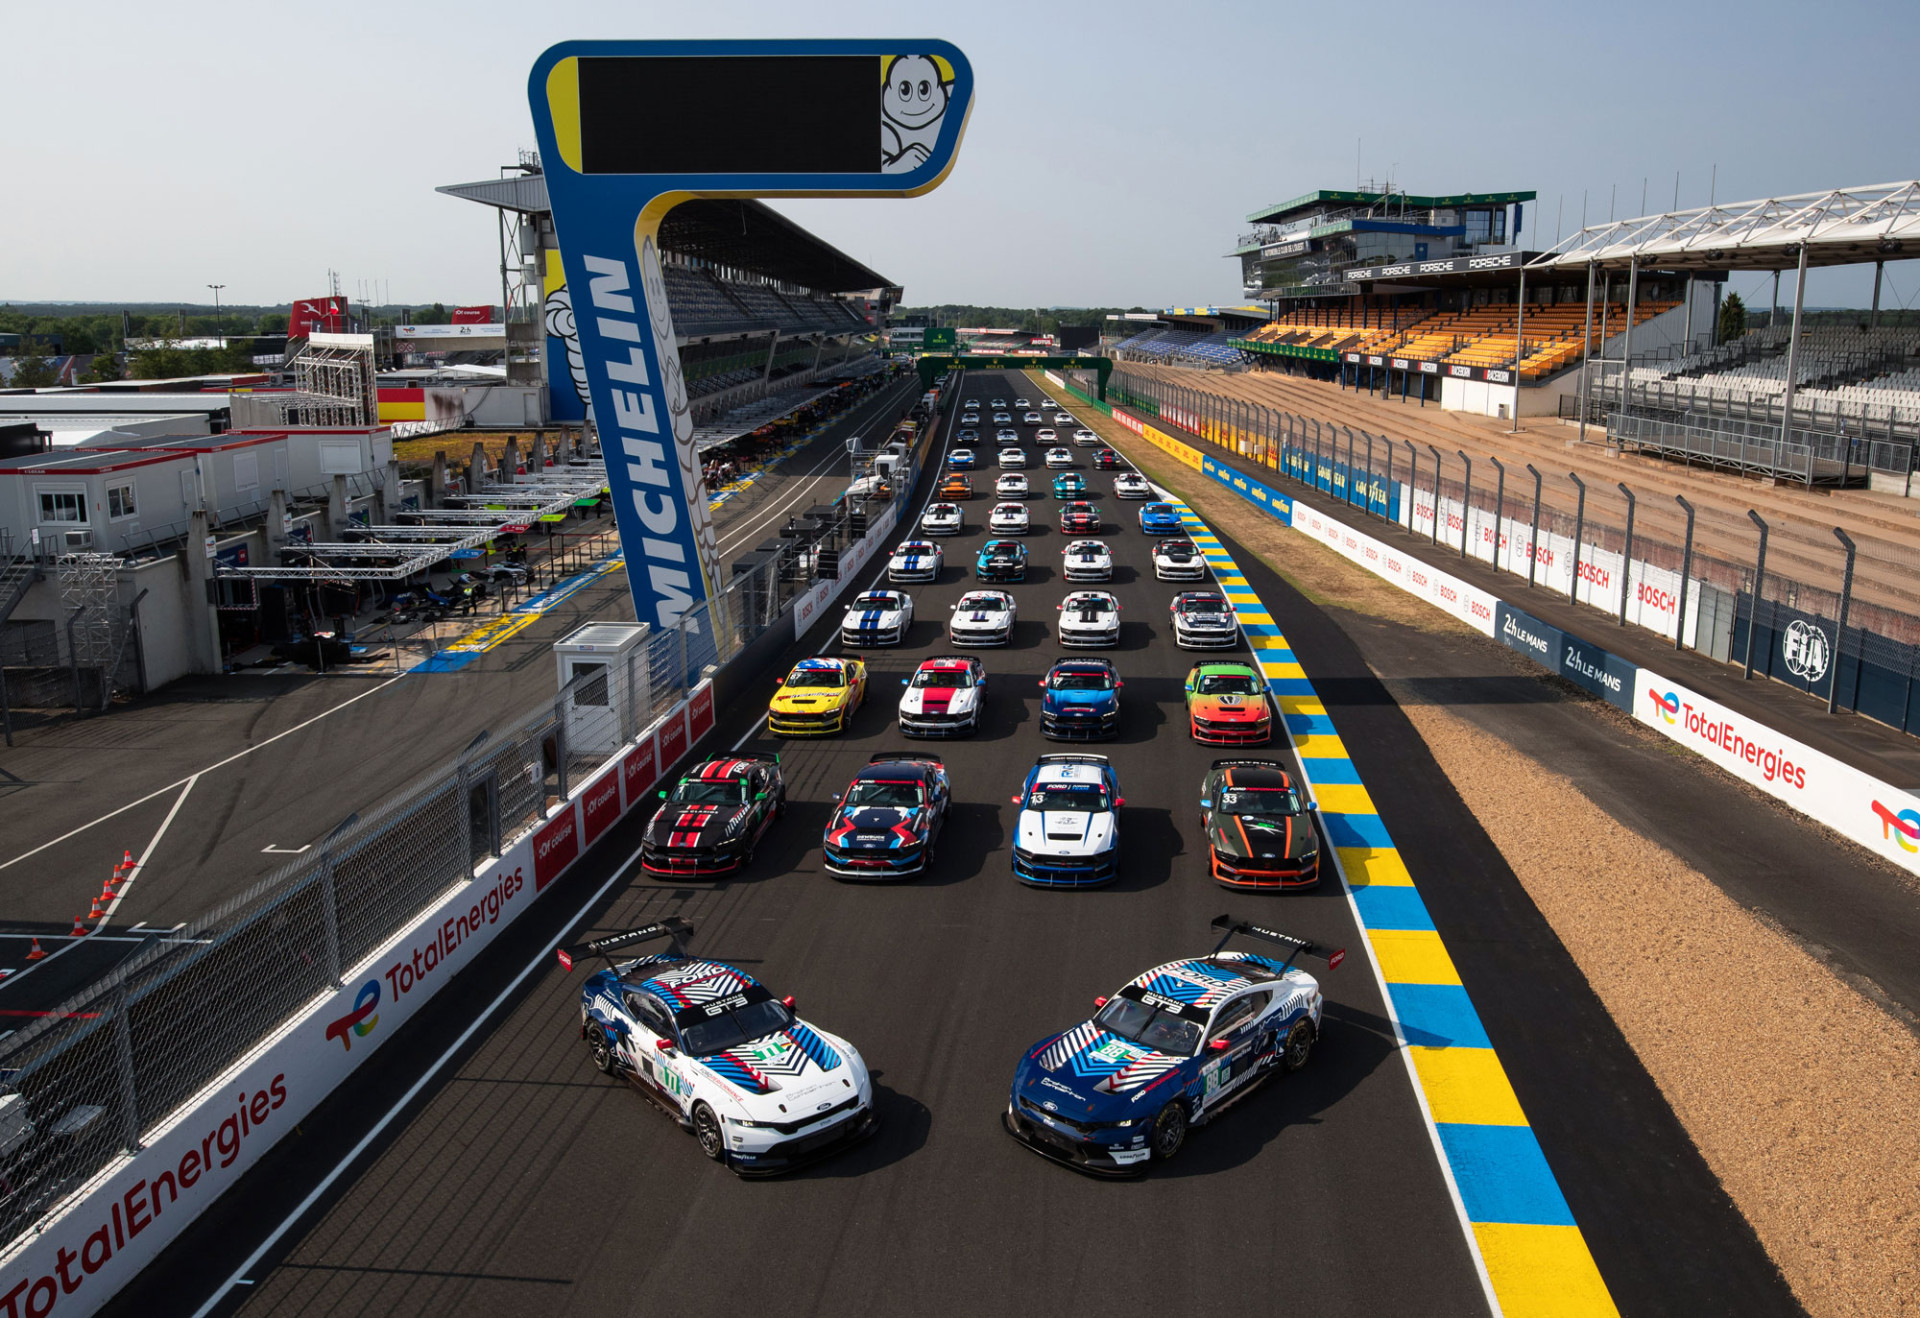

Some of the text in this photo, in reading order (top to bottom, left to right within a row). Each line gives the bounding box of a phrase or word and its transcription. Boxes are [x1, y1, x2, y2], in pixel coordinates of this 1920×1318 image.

[1382, 265, 1411, 276] PORSCHE
[1420, 261, 1454, 273] PORSCHE
[1469, 255, 1511, 269] PORSCHE
[583, 254, 700, 634] MICHELIN
[1356, 480, 1388, 505] GOODYEA
[1416, 503, 1435, 520] BOSCH
[1448, 513, 1464, 532] BOSC
[1366, 547, 1378, 561] BOSCH
[1526, 541, 1554, 567] BSCH
[1388, 558, 1401, 573] BOSCH
[1578, 561, 1609, 589] BOSCH
[1413, 571, 1428, 588] BOSCH
[1440, 585, 1457, 603] BOSCH
[1638, 582, 1676, 614] BOSCH
[1471, 601, 1490, 621] BOSCH
[1517, 628, 1526, 642] LE
[1526, 632, 1548, 653] MANS
[1582, 662, 1594, 678] LE
[1594, 669, 1621, 692] MANS
[1682, 702, 1806, 791] TotalEnergies
[597, 786, 616, 807] course
[1222, 794, 1238, 804] 33
[551, 824, 572, 848] course
[385, 866, 524, 1003] TotalEnergies
[1252, 926, 1309, 947] MUSTAN
[558, 954, 571, 966] FORD
[1330, 952, 1344, 965] FORD
[668, 966, 727, 988] FORD
[1169, 967, 1228, 988] FORD
[702, 993, 744, 1009] MUSTANG
[705, 997, 749, 1017] GT3
[1141, 995, 1183, 1014] GT3
[1146, 991, 1186, 1007] MUSTANG
[1100, 1044, 1126, 1058] 88
[1206, 1068, 1219, 1094] 88
[0, 1073, 287, 1318] TotalEnergies
